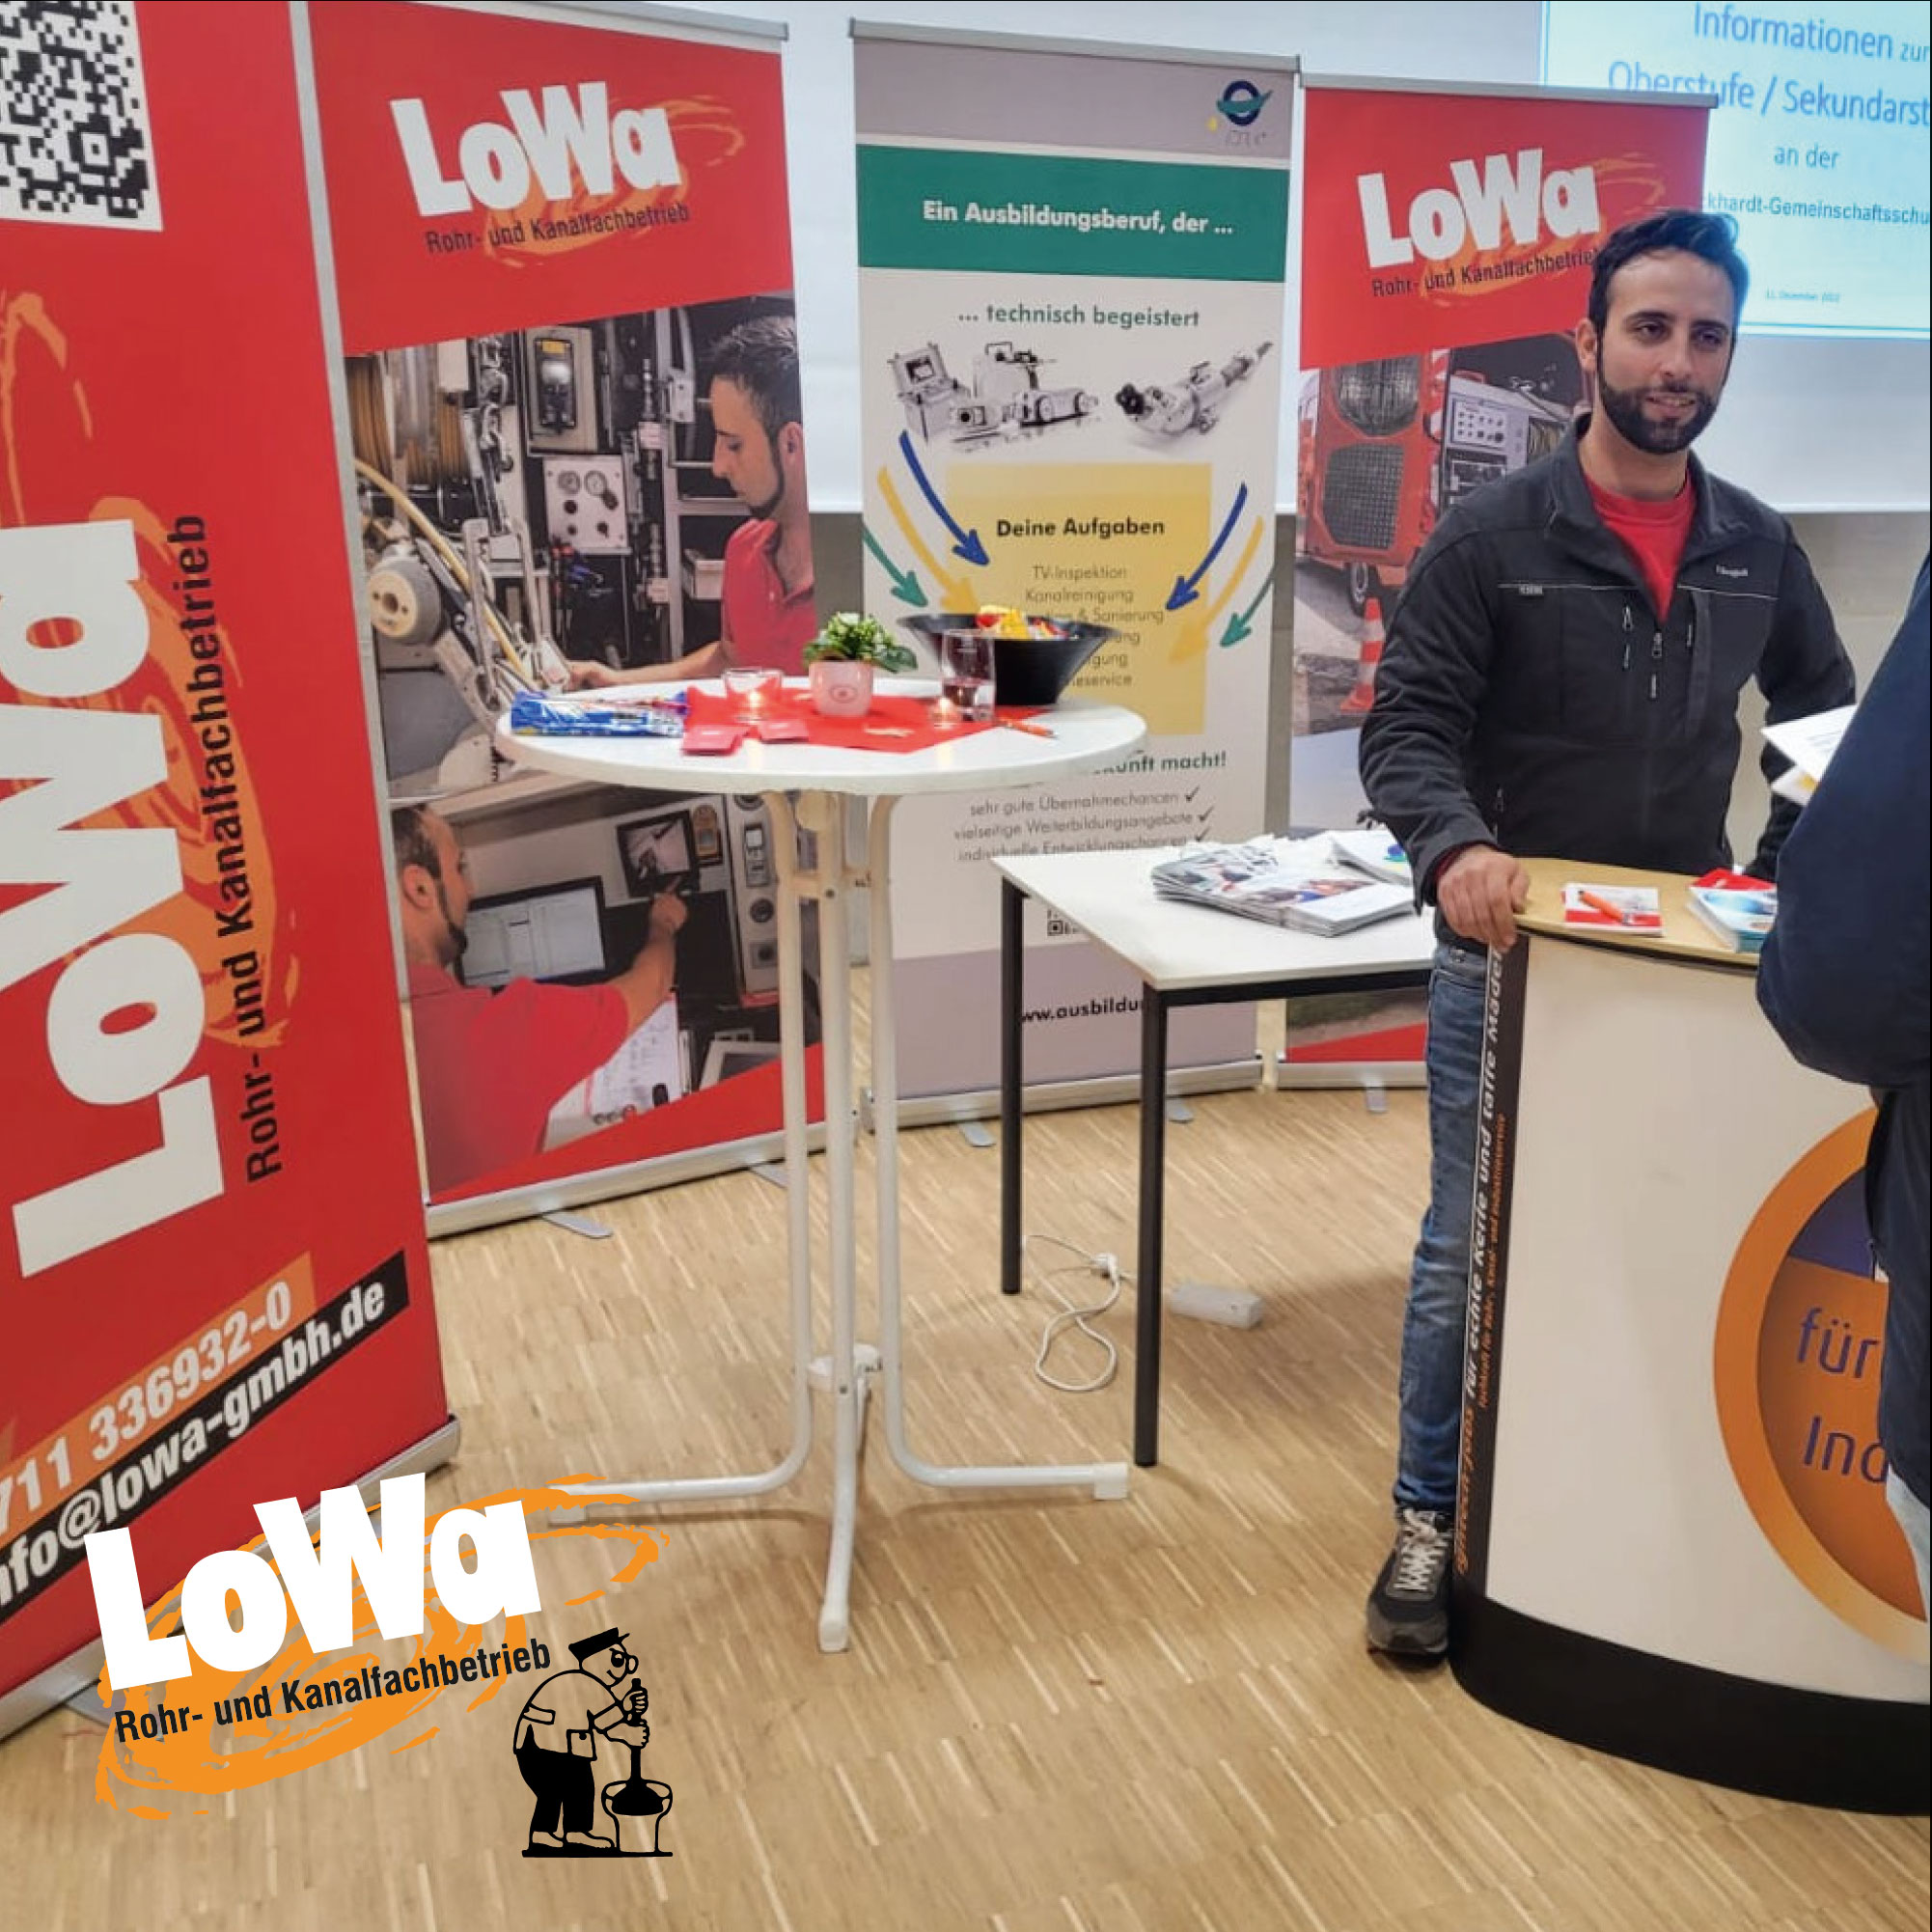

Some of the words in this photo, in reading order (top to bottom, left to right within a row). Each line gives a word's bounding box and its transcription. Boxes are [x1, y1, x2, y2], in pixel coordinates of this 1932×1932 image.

[1694, 2, 1893, 60] Informationen
[1900, 42, 1929, 64] zur
[1784, 80, 1929, 128] Sekundarst
[390, 81, 681, 217] LoWa
[1775, 145, 1799, 167] an
[1807, 145, 1839, 169] der
[426, 227, 481, 254] Rohr-
[489, 221, 526, 247] und
[532, 204, 690, 240] Kanalfachbetrieb
[923, 199, 958, 222] Ein
[965, 202, 1166, 235] Ausbildungsberuf,
[1172, 210, 1208, 234] der
[1357, 148, 1600, 269] LoWa
[1371, 277, 1420, 298] Rohr-
[1424, 268, 1455, 292] und
[1461, 249, 1598, 285] Kanalfachbetrie
[986, 303, 1086, 324] technisch
[1092, 305, 1200, 329] begeistert
[997, 518, 1056, 538] Deine
[1063, 516, 1165, 539] Aufgaben
[1025, 587, 1134, 604] Kanalreinigung
[1093, 608, 1164, 623] Sanierung
[167, 513, 255, 940] Kanalfachbetrieb
[1161, 750, 1227, 771] macht!
[970, 794, 998, 816] sehr
[1004, 797, 1035, 815] gute
[0, 519, 224, 1279] LoWa
[239, 950, 267, 1039] und
[1021, 996, 1143, 1023] ww.ausbildu
[247, 1052, 282, 1184] Rohr-
[1479, 1124, 1492, 1183] und
[1796, 1307, 1881, 1379] für
[89, 1281, 292, 1460] 336932-0
